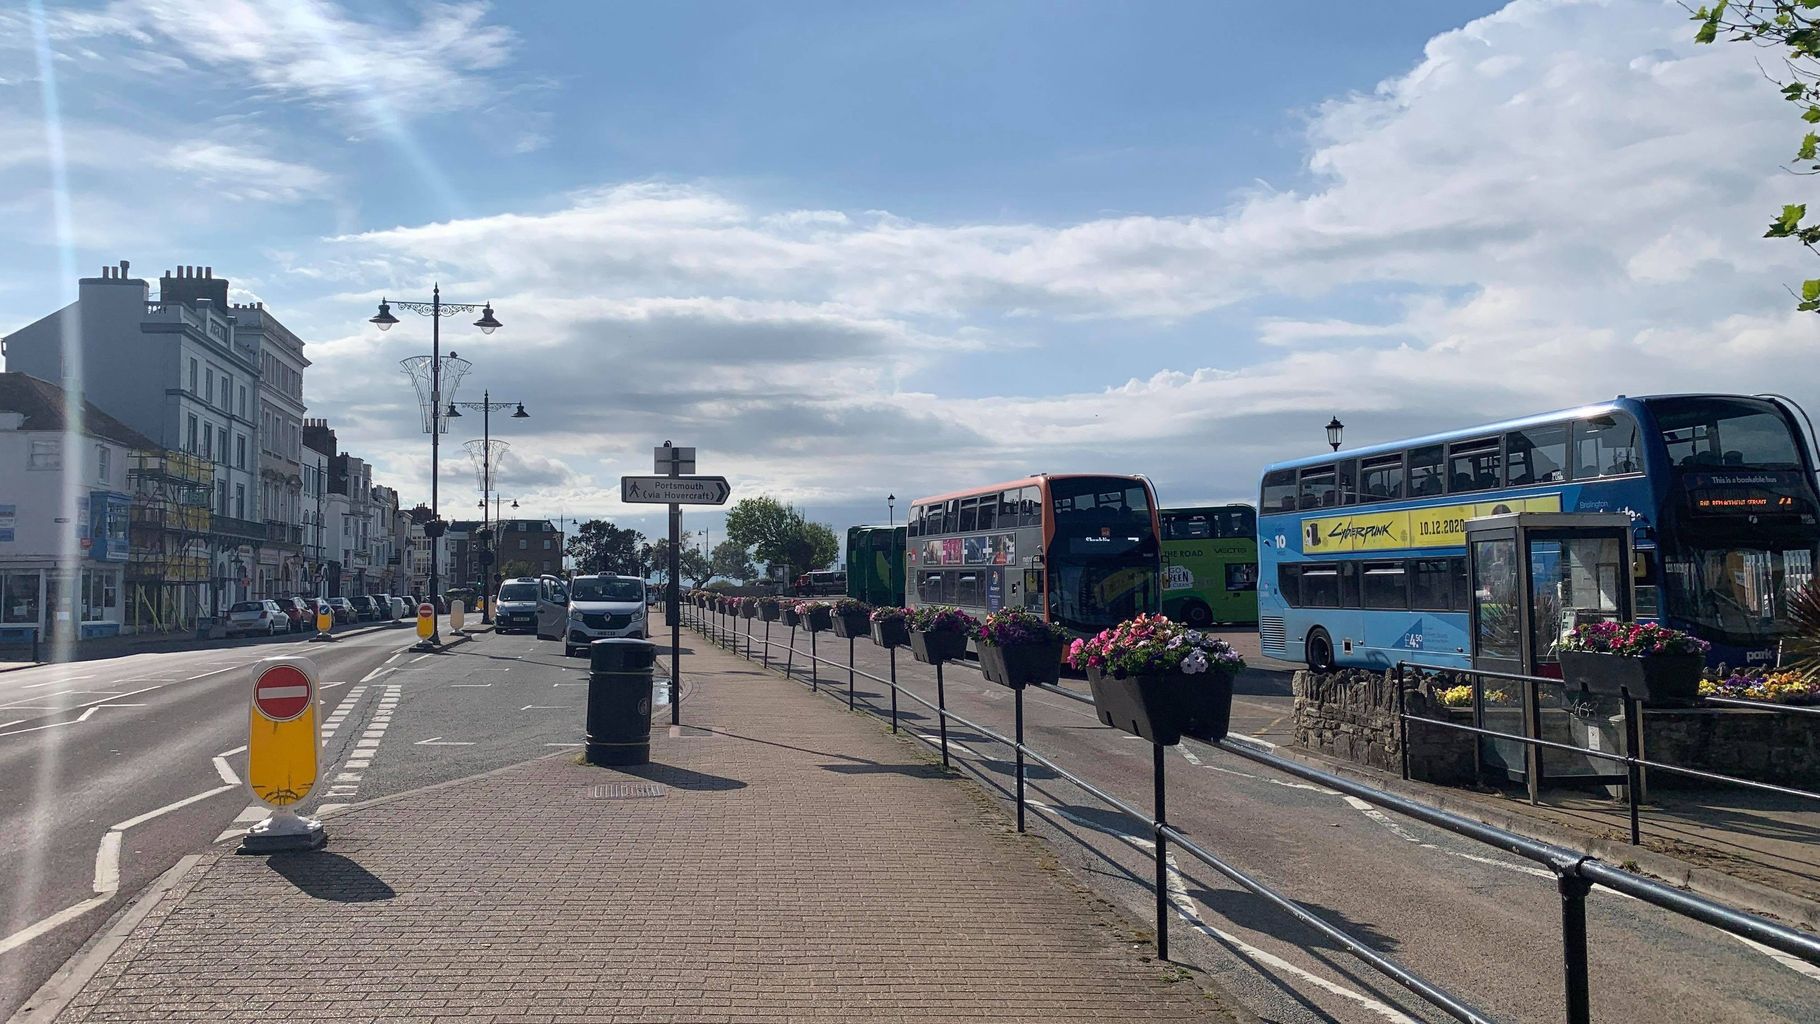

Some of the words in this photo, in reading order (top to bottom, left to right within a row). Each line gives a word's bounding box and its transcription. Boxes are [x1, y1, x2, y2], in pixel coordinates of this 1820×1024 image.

[655, 481, 704, 490] Portsmouth
[642, 491, 660, 499] (via
[664, 491, 714, 500] Hovercraft)
[1419, 518, 1465, 536] 10.12.2020
[1275, 535, 1286, 549] 10
[1746, 649, 1773, 663] park
